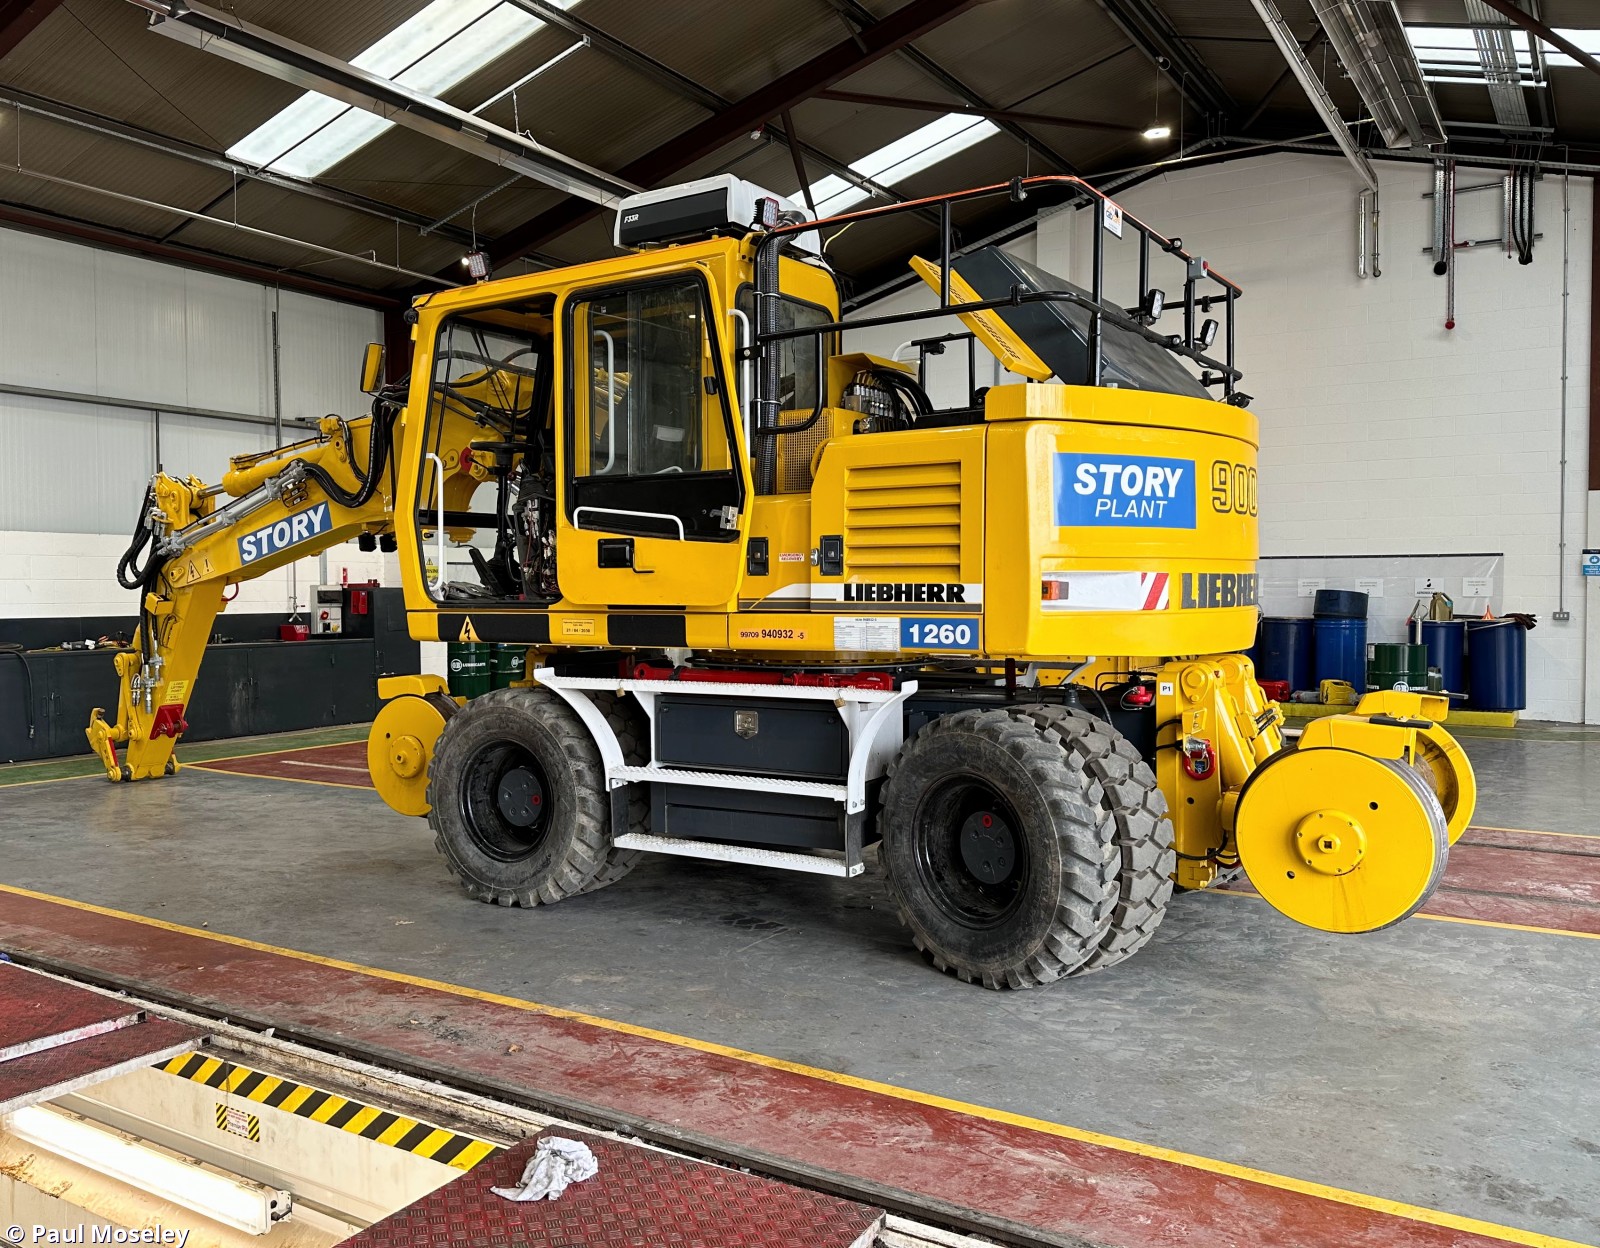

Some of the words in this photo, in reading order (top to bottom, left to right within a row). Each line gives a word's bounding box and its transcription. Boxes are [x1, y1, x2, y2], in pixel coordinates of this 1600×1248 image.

[1073, 463, 1183, 498] STORY
[1095, 498, 1168, 519] PLANT
[242, 503, 326, 562] STORY
[843, 583, 966, 603] LIEBHERR
[761, 629, 794, 639] 940932
[797, 632, 805, 640] -5
[909, 623, 971, 645] 1260
